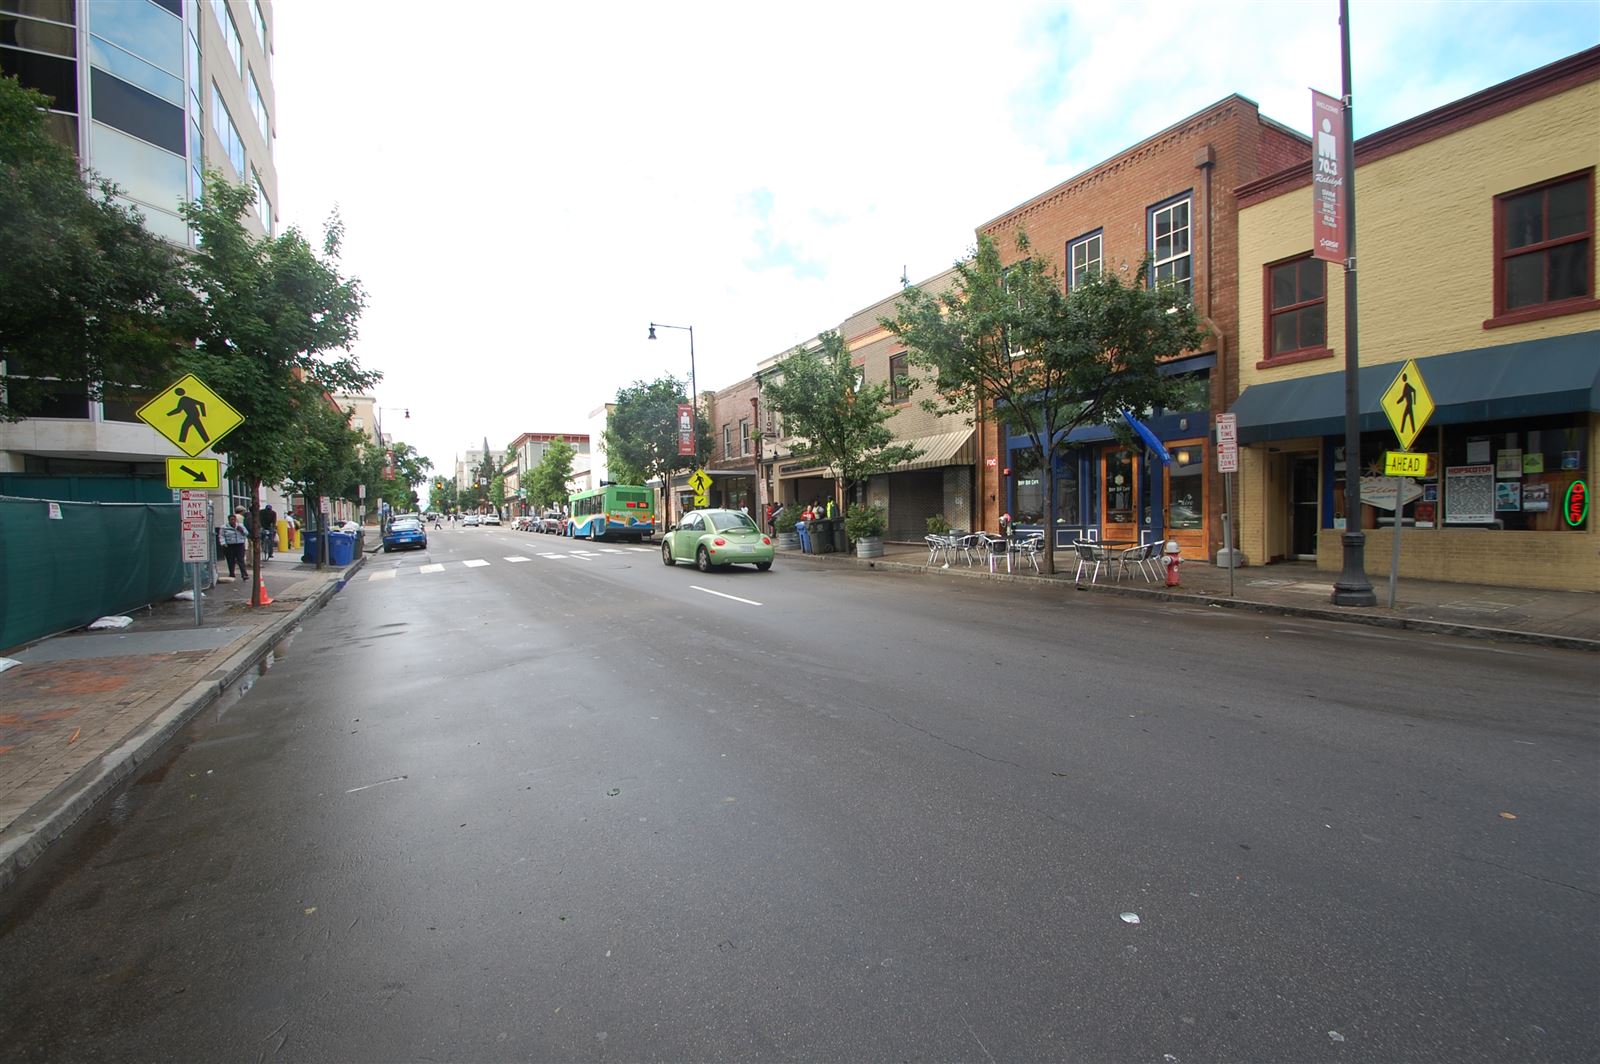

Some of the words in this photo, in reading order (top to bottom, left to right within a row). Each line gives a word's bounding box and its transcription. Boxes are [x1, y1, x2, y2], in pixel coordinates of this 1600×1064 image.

[1319, 157, 1337, 176] 70.3
[1391, 457, 1420, 472] AHEAD
[1570, 483, 1585, 522] OPEN
